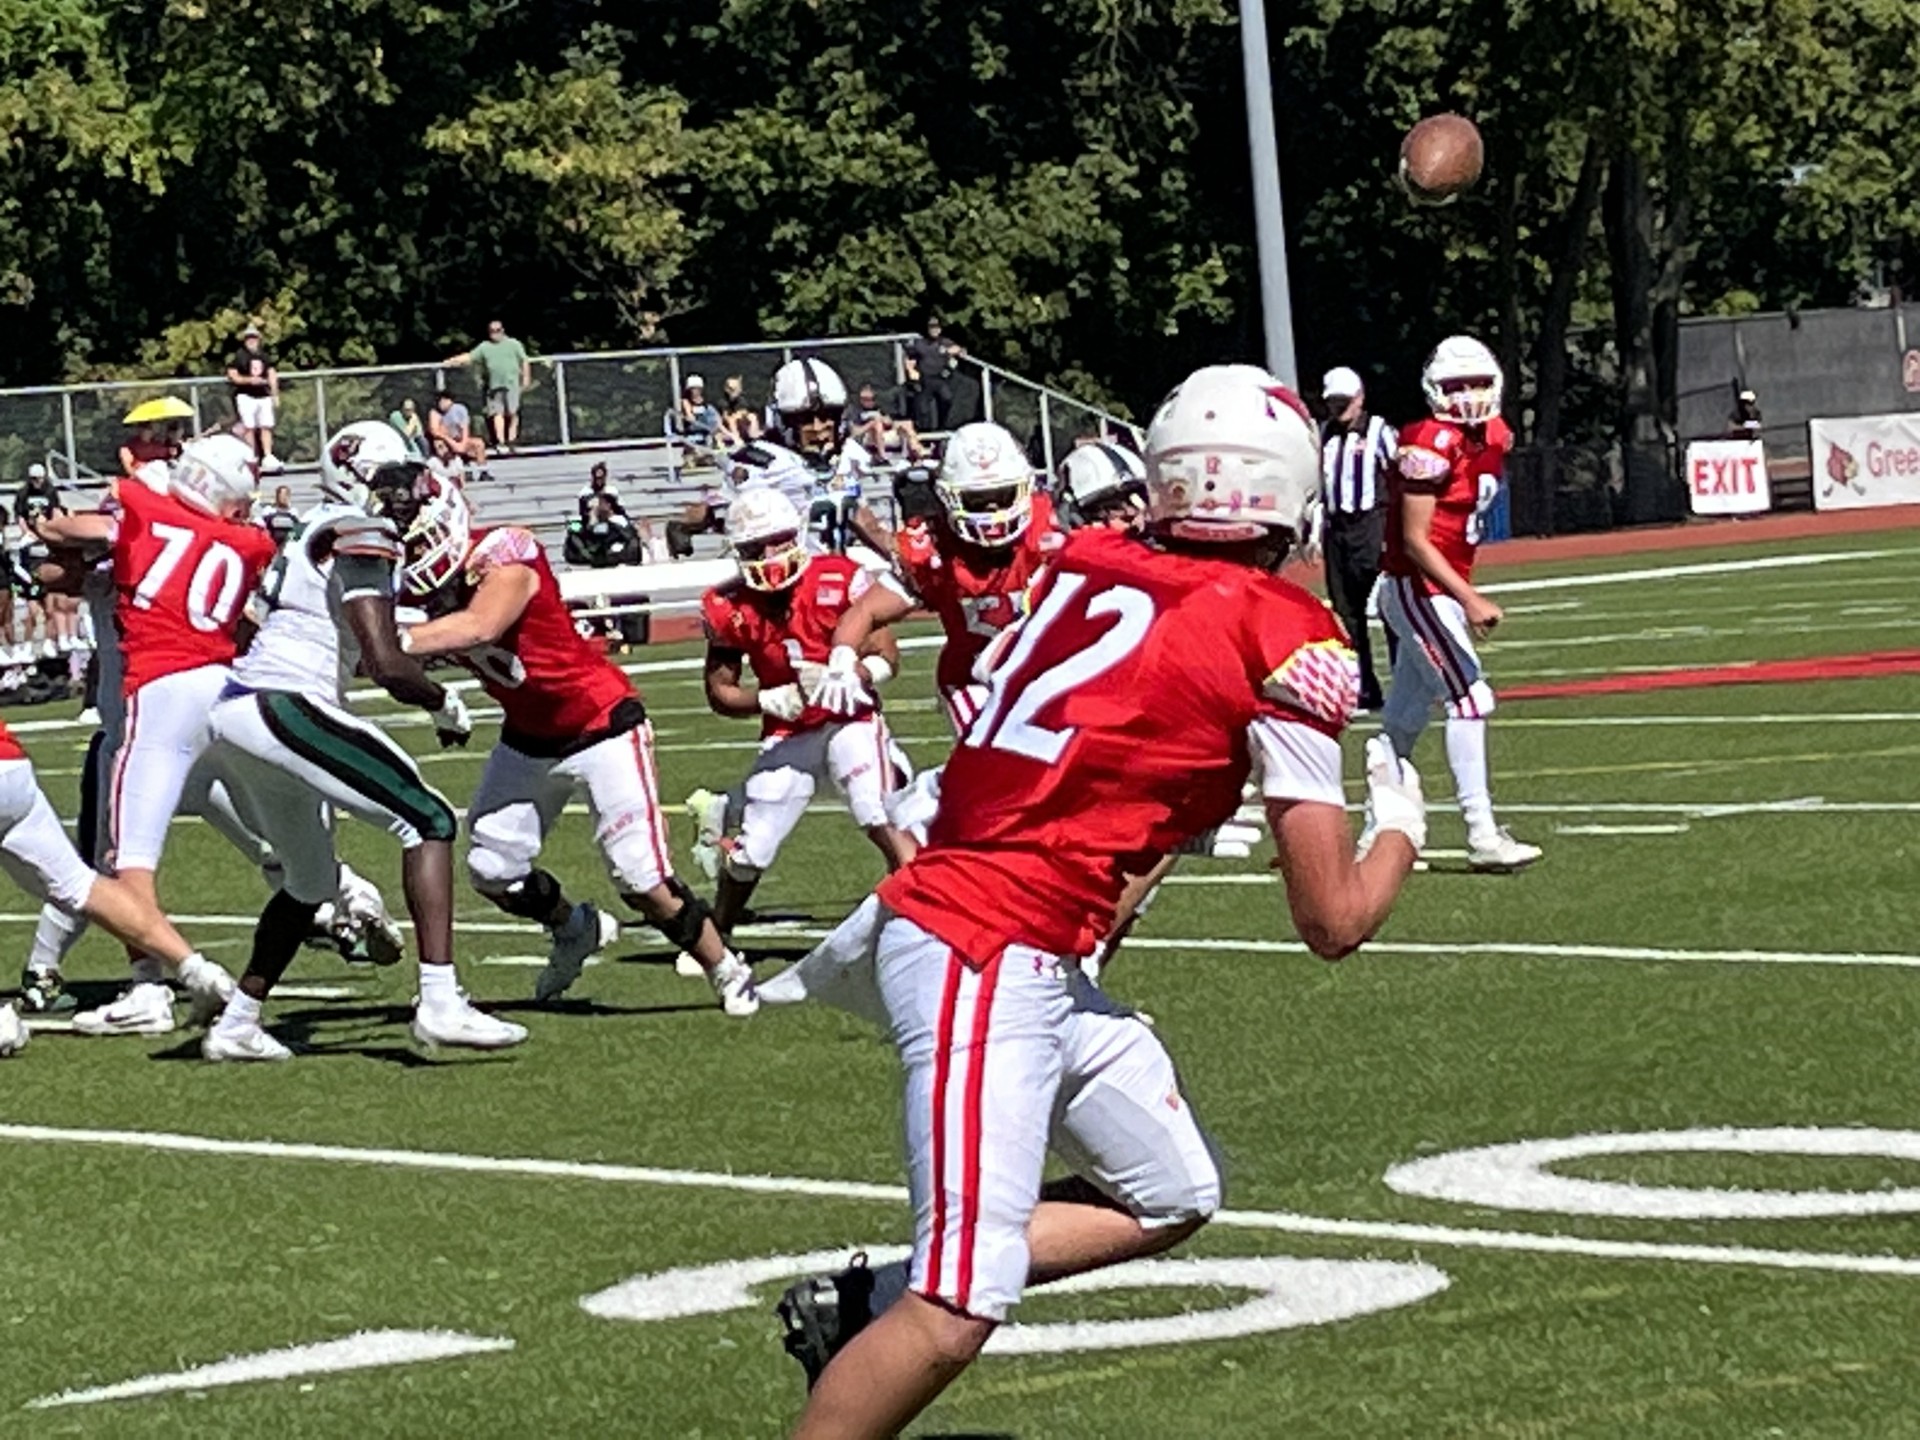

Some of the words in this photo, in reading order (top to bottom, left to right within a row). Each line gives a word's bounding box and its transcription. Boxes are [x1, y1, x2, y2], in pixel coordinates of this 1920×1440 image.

[1693, 457, 1760, 496] EXIT
[132, 520, 245, 633] 70
[964, 570, 1157, 765] 12
